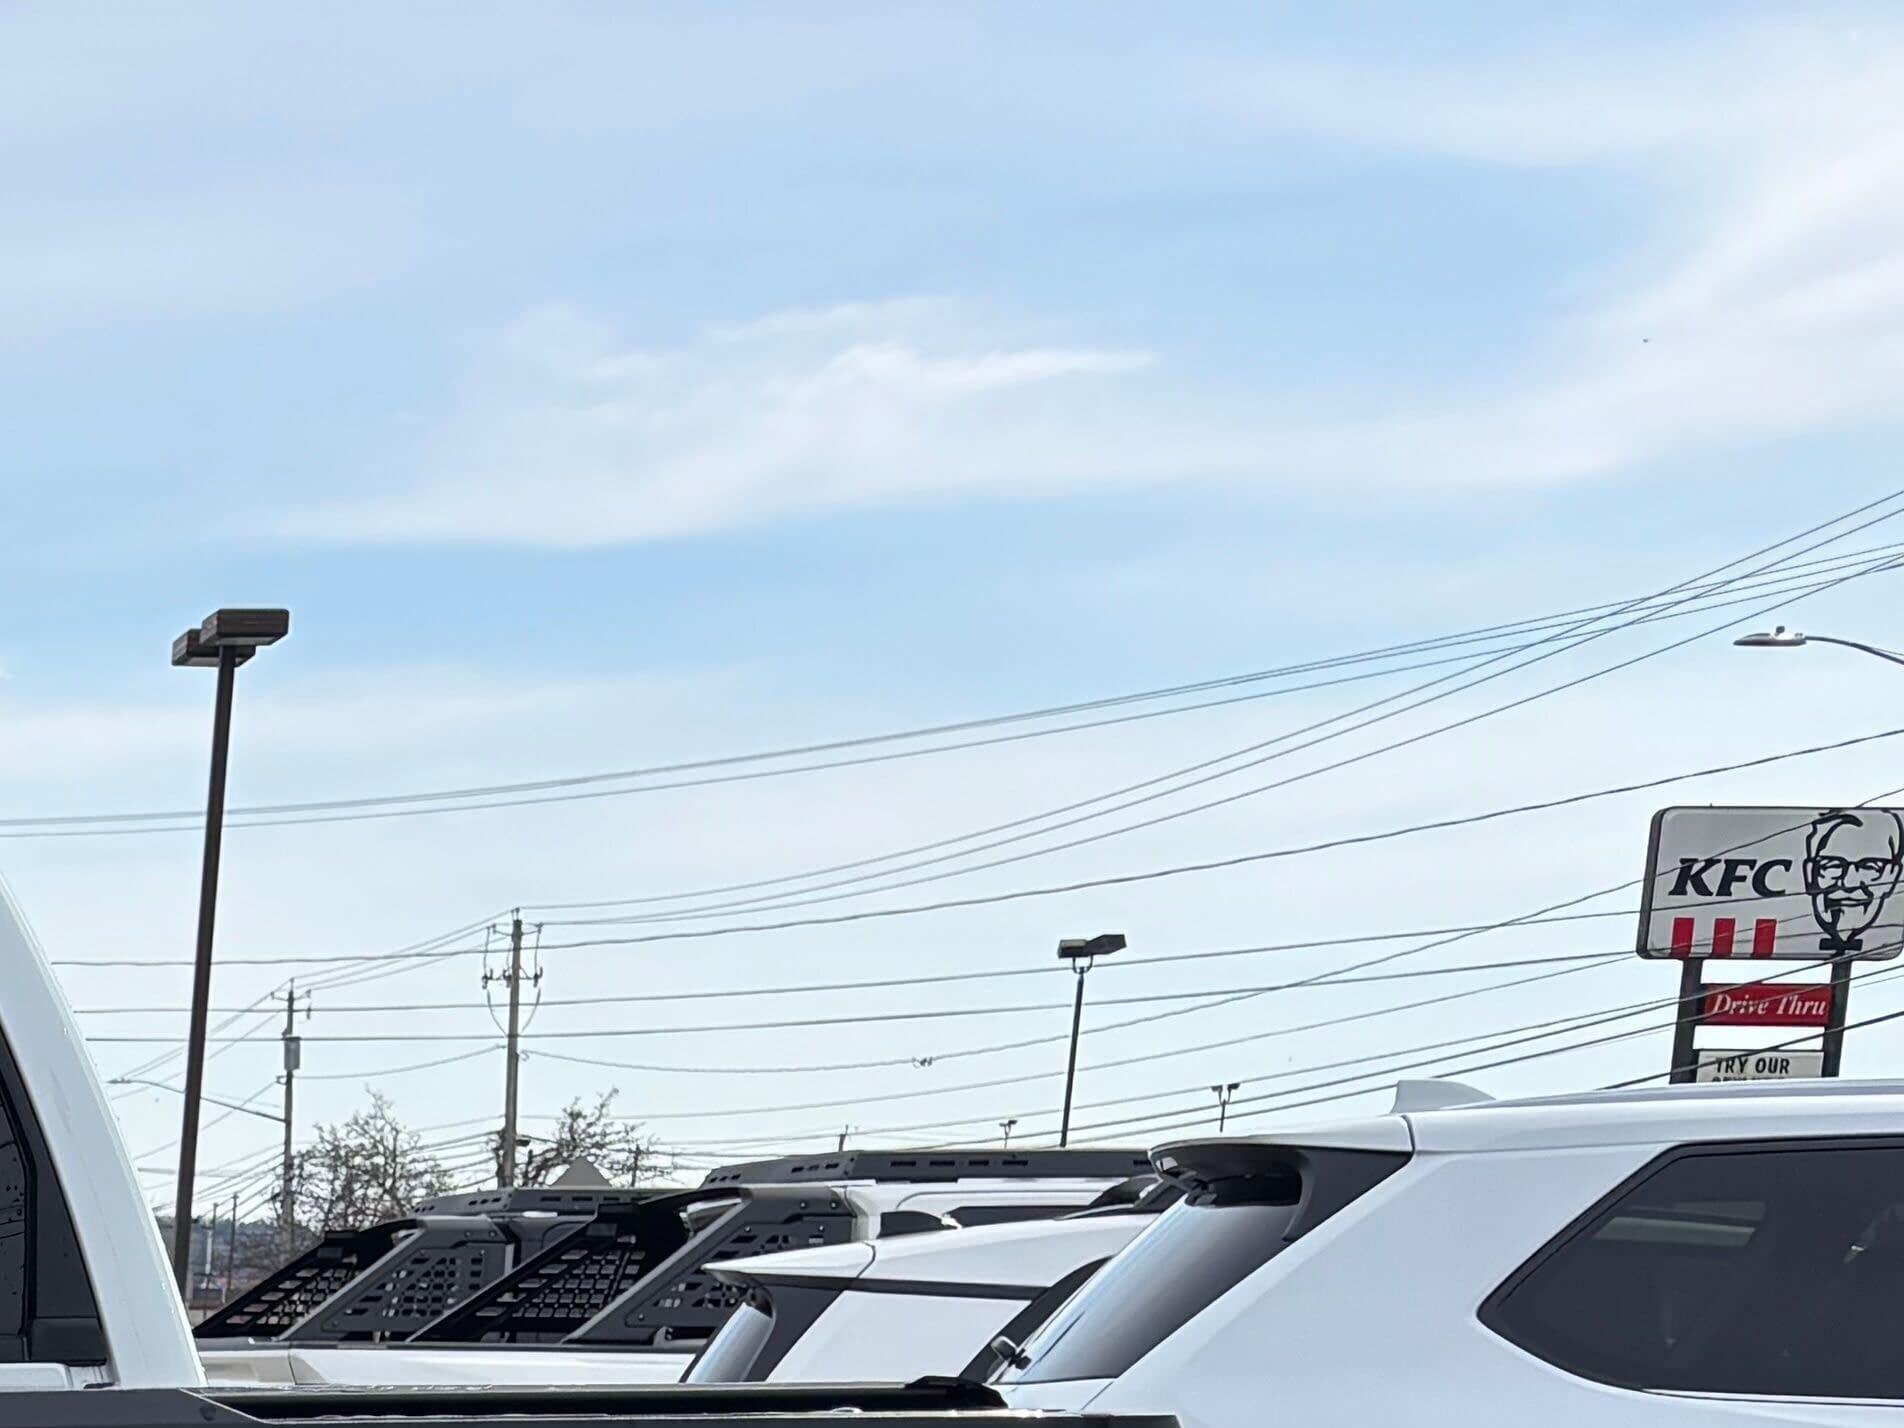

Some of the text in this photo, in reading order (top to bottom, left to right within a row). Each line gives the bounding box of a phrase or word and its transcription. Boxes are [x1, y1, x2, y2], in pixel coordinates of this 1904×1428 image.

[1668, 858, 1792, 897] KFC
[1712, 994, 1826, 1015] Drive Thru
[1715, 1057, 1790, 1074] TRY OUR
